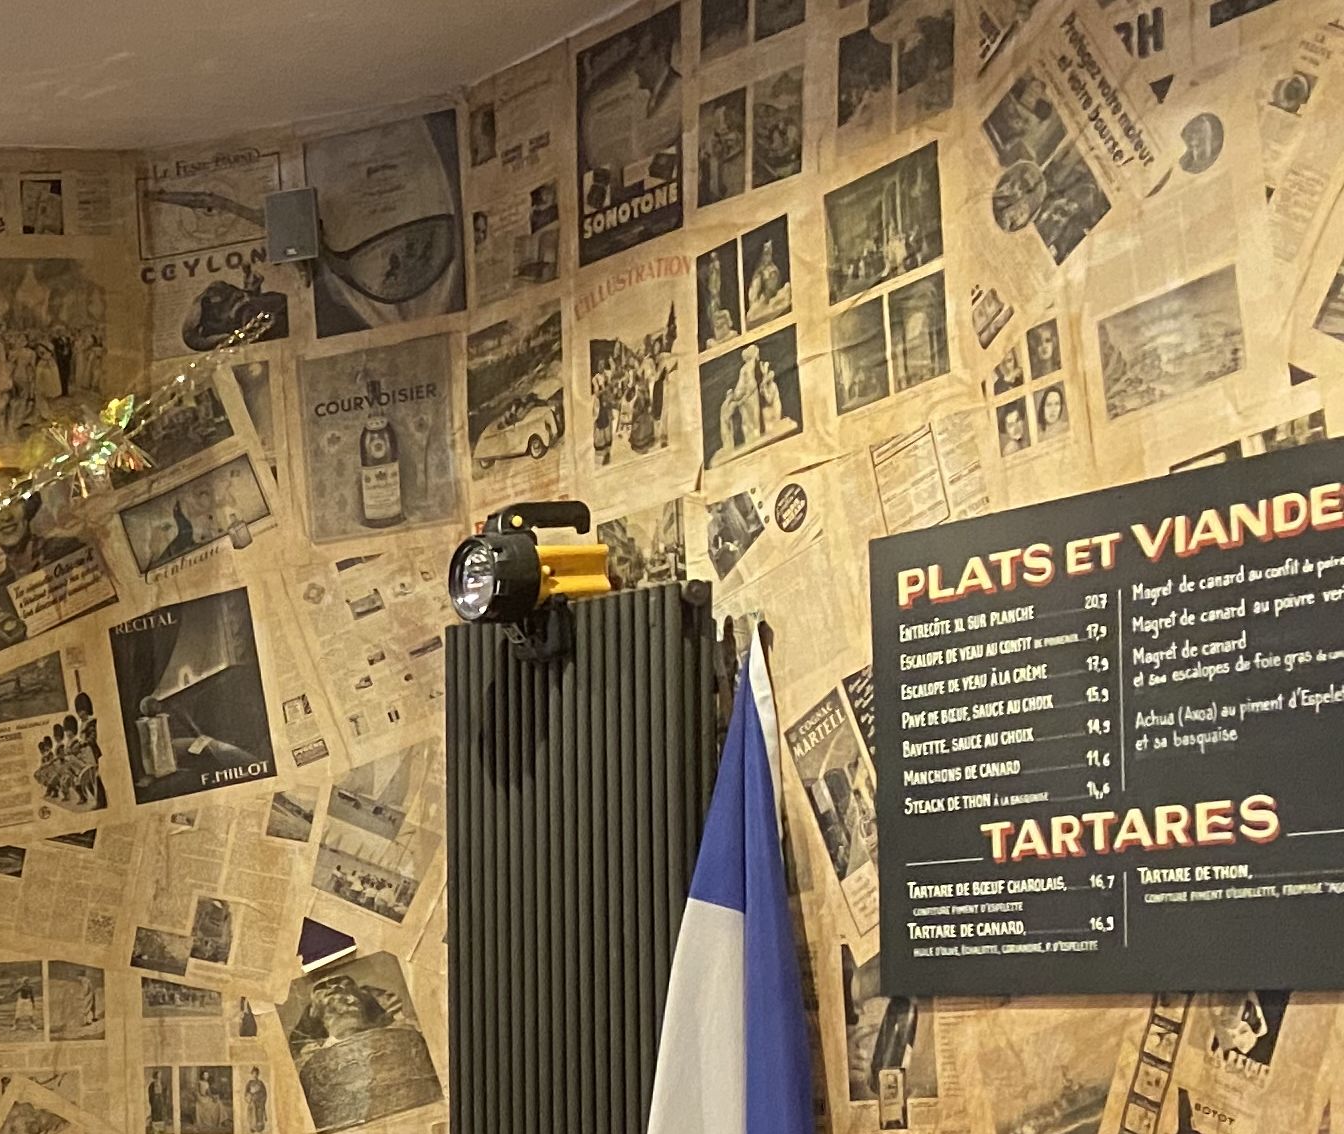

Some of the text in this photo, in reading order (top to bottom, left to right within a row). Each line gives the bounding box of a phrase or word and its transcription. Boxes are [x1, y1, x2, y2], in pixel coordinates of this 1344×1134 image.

[583, 182, 678, 239] SONOTONE
[141, 247, 266, 286] CEYLON
[314, 383, 437, 418] COURVOISIER
[898, 543, 1055, 608] PLATS
[1066, 532, 1123, 575] ET
[1132, 581, 1173, 606] Magret
[1179, 575, 1195, 593] de
[1199, 564, 1245, 589] canard
[1248, 569, 1262, 582] au
[1265, 558, 1299, 579] confit
[115, 611, 177, 635] RECITAL
[954, 619, 965, 633] XL
[968, 615, 986, 630] SUR
[990, 605, 1034, 626] PLANCHE
[1132, 591, 1315, 639] Magret de canard au poivre
[900, 651, 943, 670] ESCALOPE
[946, 652, 957, 664] DE
[960, 643, 983, 661] VEAU
[986, 642, 997, 657] AU
[999, 637, 1032, 655] CONFIT
[1132, 630, 1247, 669] Magret de canard
[1172, 661, 1230, 682] escalopes
[1235, 655, 1251, 672] de
[1254, 650, 1281, 669] foie
[1284, 650, 1312, 672] gras
[901, 680, 944, 700] ESCALOPE
[948, 679, 960, 693] DE
[963, 673, 987, 691] VEAU
[999, 671, 1011, 686] LA
[928, 711, 939, 726] DE
[972, 701, 1005, 720] SAUCE
[1006, 699, 1020, 714] AU
[1022, 694, 1054, 713] CHOIX
[1220, 705, 1236, 718] au
[1240, 694, 1284, 722] piment
[792, 708, 846, 761] MARTELL
[952, 732, 982, 751] SAUCE
[984, 732, 998, 748] AU
[1001, 728, 1034, 746] CHOIX
[1135, 727, 1239, 755] et sa basquaise
[904, 766, 961, 786] MANCHONS
[965, 765, 977, 779] DE
[980, 760, 1020, 778] CANARD
[904, 793, 991, 815] STEACK DE THON
[980, 794, 1281, 863] TARTARES
[907, 882, 954, 899] TARTARE
[956, 882, 970, 896] DE
[1137, 867, 1191, 885] TARTARE
[1195, 866, 1212, 882] DE
[907, 922, 956, 940] TARTARE
[961, 923, 973, 937] DE
[1195, 1103, 1235, 1126] BOTOT
